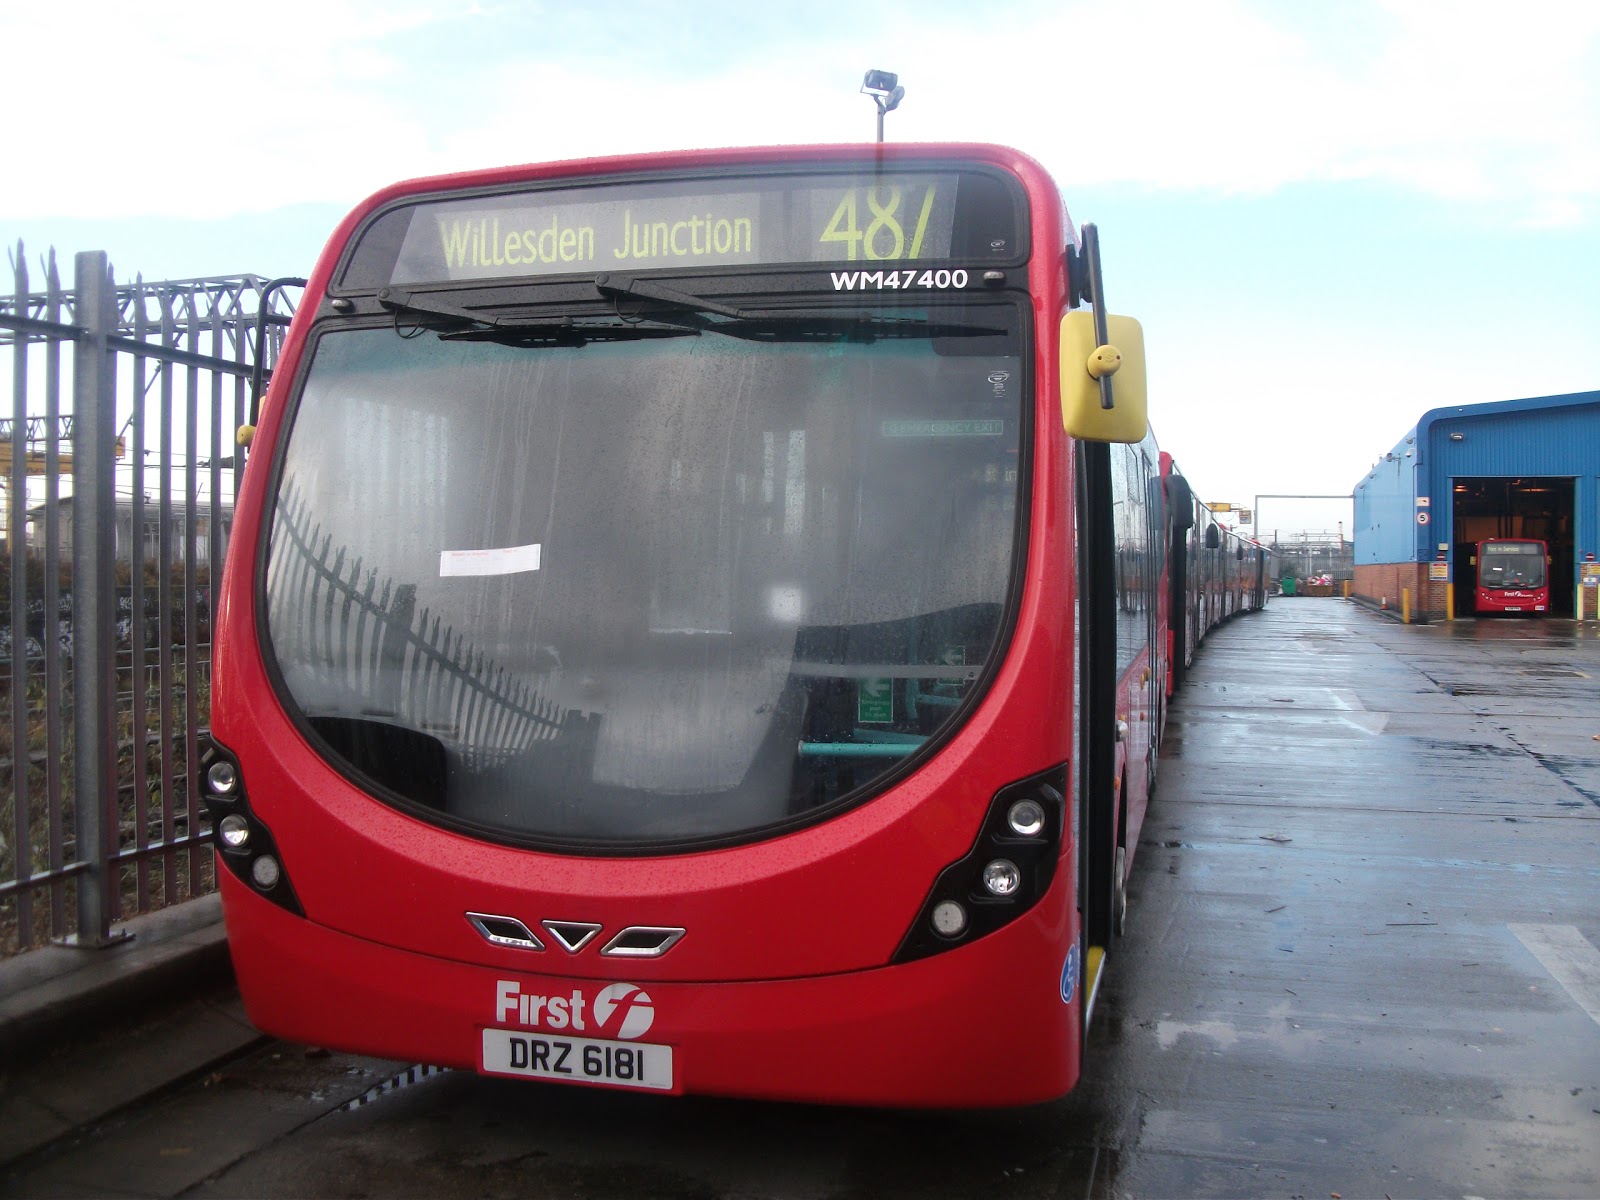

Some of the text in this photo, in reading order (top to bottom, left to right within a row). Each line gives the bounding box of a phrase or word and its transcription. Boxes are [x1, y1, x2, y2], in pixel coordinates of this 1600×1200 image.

[438, 208, 751, 268] Willesden Junction
[830, 269, 968, 291] WM47400
[974, 422, 999, 432] EXIT
[1419, 514, 1426, 522] 5
[496, 979, 586, 1031] First
[509, 1037, 644, 1081] DRZ 6181
